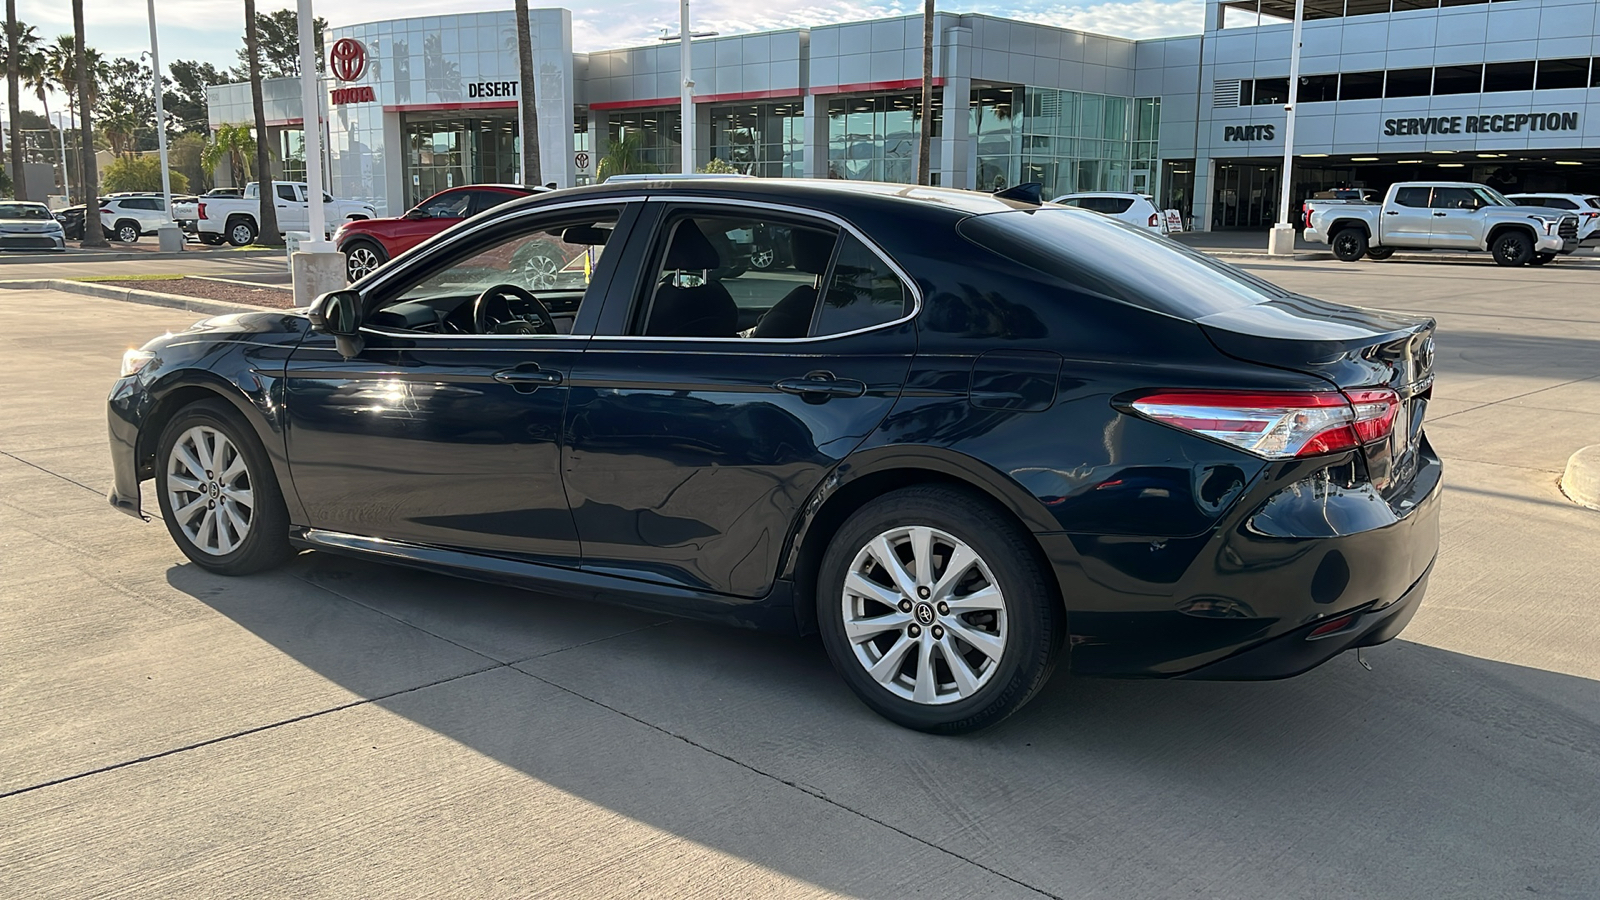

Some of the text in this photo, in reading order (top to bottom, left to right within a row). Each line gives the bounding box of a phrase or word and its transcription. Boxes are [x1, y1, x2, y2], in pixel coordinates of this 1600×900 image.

[329, 86, 376, 105] TOYOTA
[468, 81, 519, 98] DESERT
[1224, 124, 1275, 142] PARTS
[1384, 112, 1578, 136] SERVICE RECEPTION
